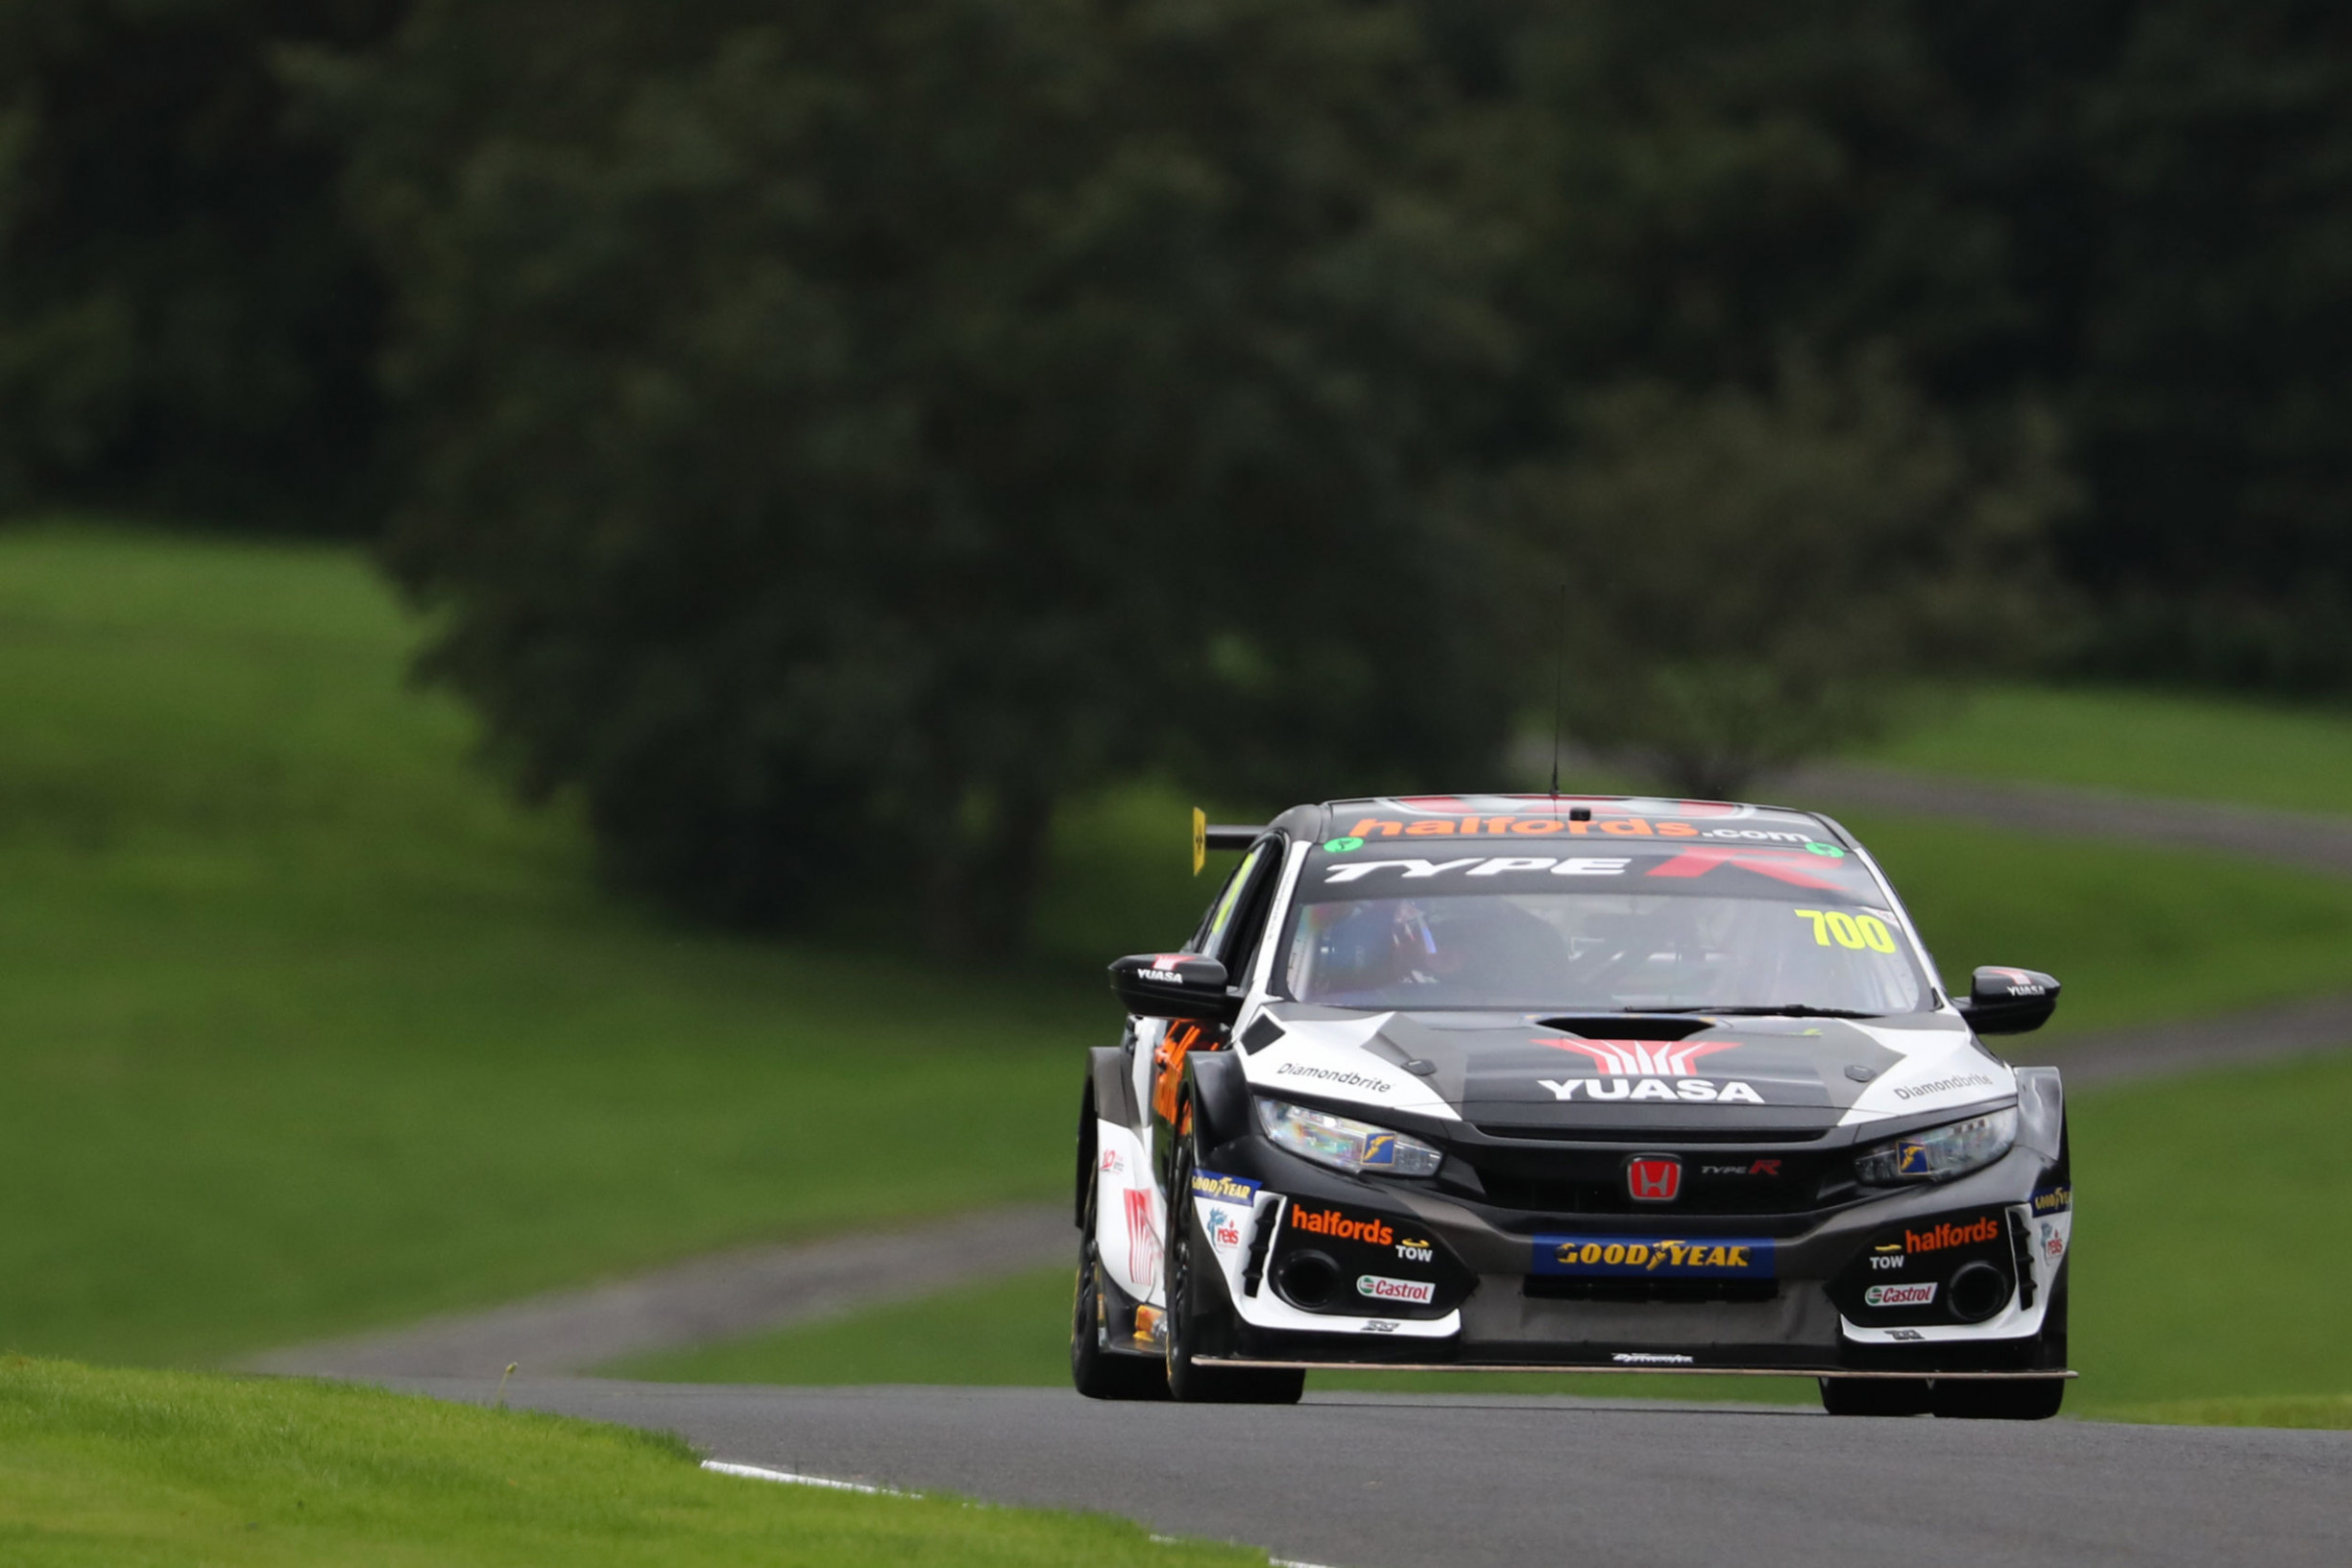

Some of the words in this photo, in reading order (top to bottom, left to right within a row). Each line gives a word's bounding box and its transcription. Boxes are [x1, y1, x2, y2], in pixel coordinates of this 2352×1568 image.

[1324, 857, 1632, 883] TYPE
[1644, 845, 1852, 891] R
[1794, 908, 1897, 954] 700
[1137, 968, 1183, 984] YUASA
[2006, 984, 2046, 997] YUASA
[1275, 1062, 1392, 1094] Diamondbrite
[1893, 1073, 1994, 1100] Diamondbrite
[1537, 1078, 1765, 1103] YUASA
[1749, 1159, 1782, 1175] R
[1217, 1220, 1239, 1244] reis
[1292, 1204, 1394, 1245] halfords
[1905, 1217, 1998, 1254] halfords
[1394, 1244, 1433, 1263] TOW
[1870, 1255, 1904, 1269] TOW
[1375, 1279, 1430, 1300] Castrol
[1882, 1286, 1930, 1303] Castrol
